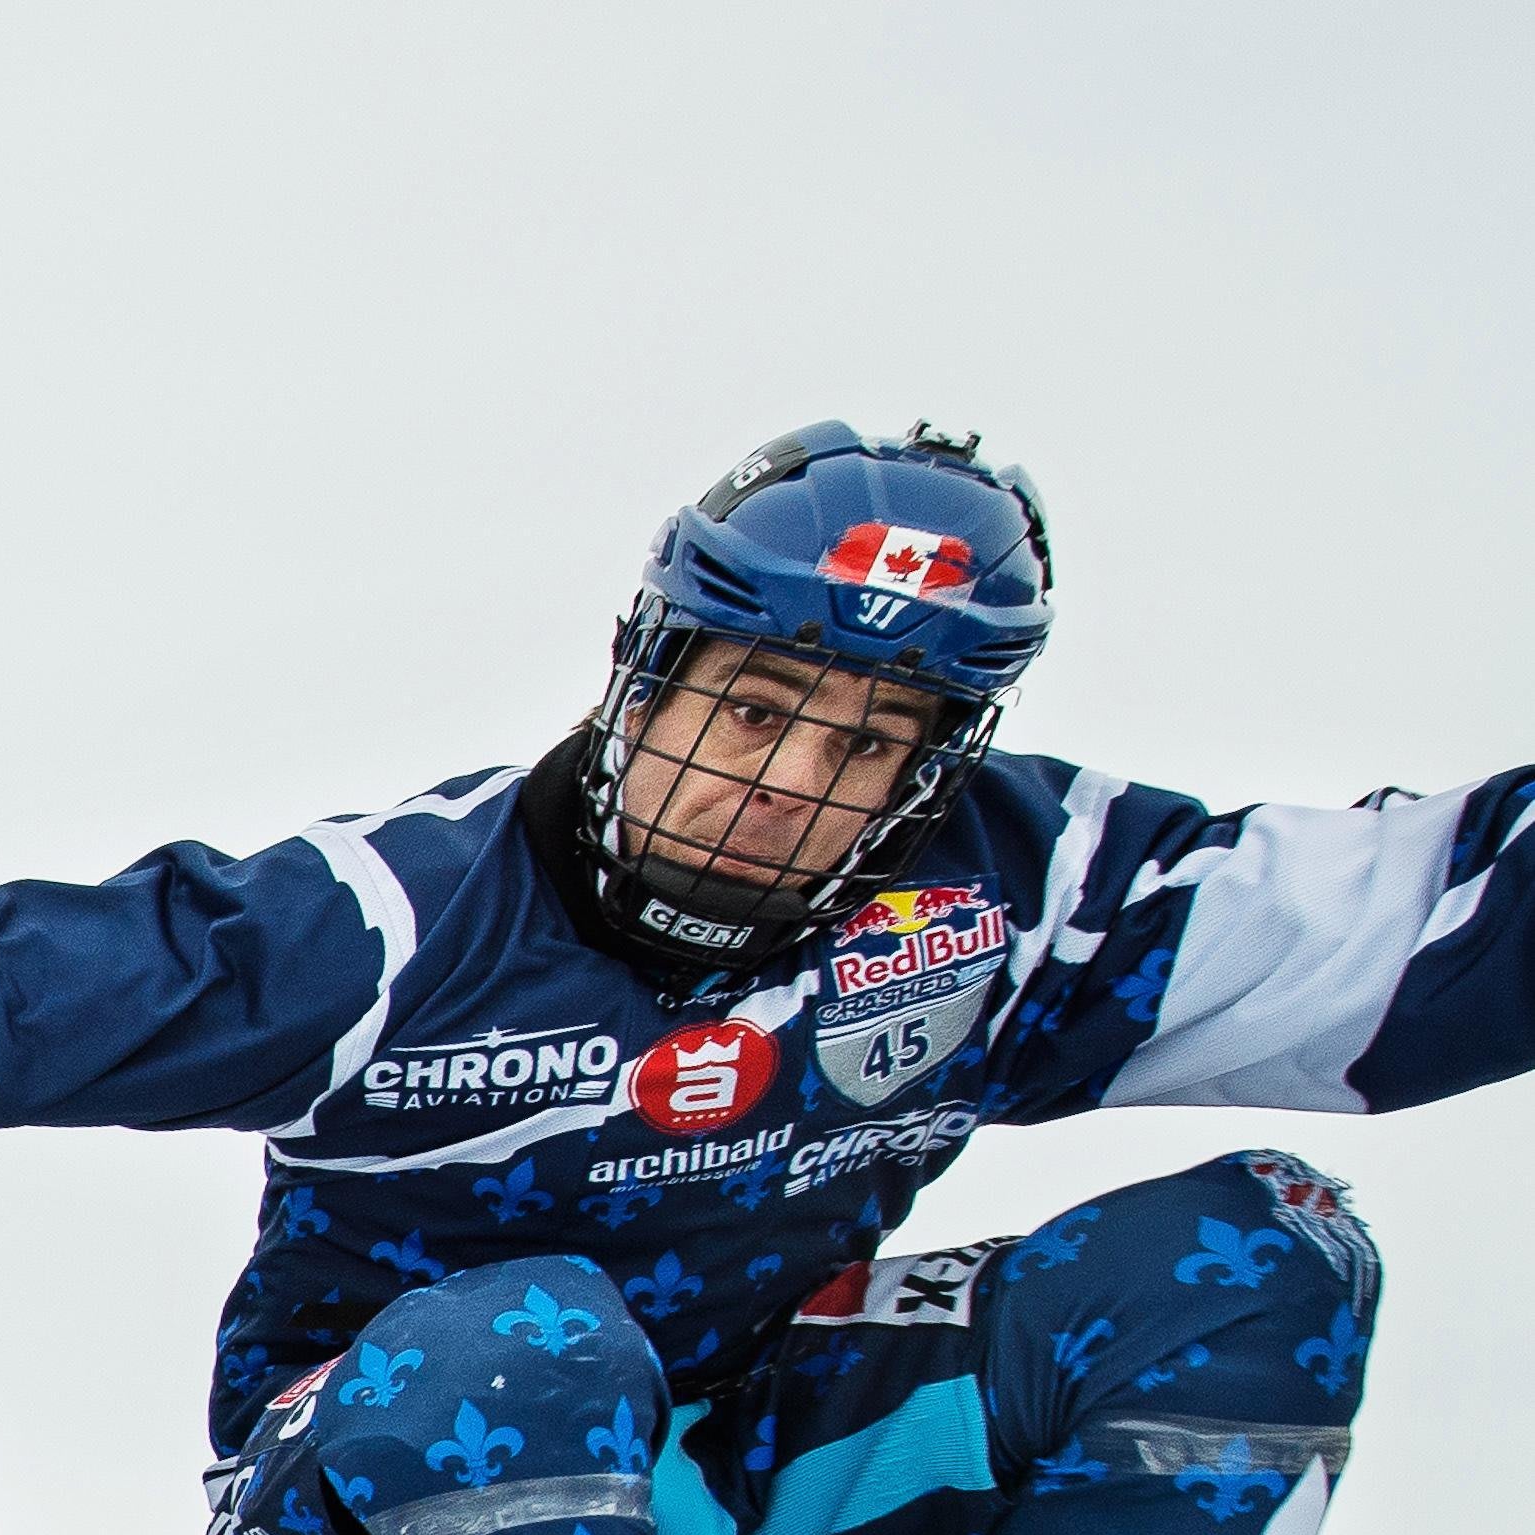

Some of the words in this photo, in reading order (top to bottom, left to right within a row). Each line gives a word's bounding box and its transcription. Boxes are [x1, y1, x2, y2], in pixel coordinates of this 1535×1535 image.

[640, 899, 755, 948] CCM
[831, 934, 923, 998] Red
[919, 905, 1006, 972] Bull
[817, 969, 959, 1026] CRASHED
[363, 1035, 619, 1091] CHRONO
[860, 1014, 931, 1083] 45
[403, 1082, 572, 1112] AVIATION
[588, 1122, 795, 1183] archibald
